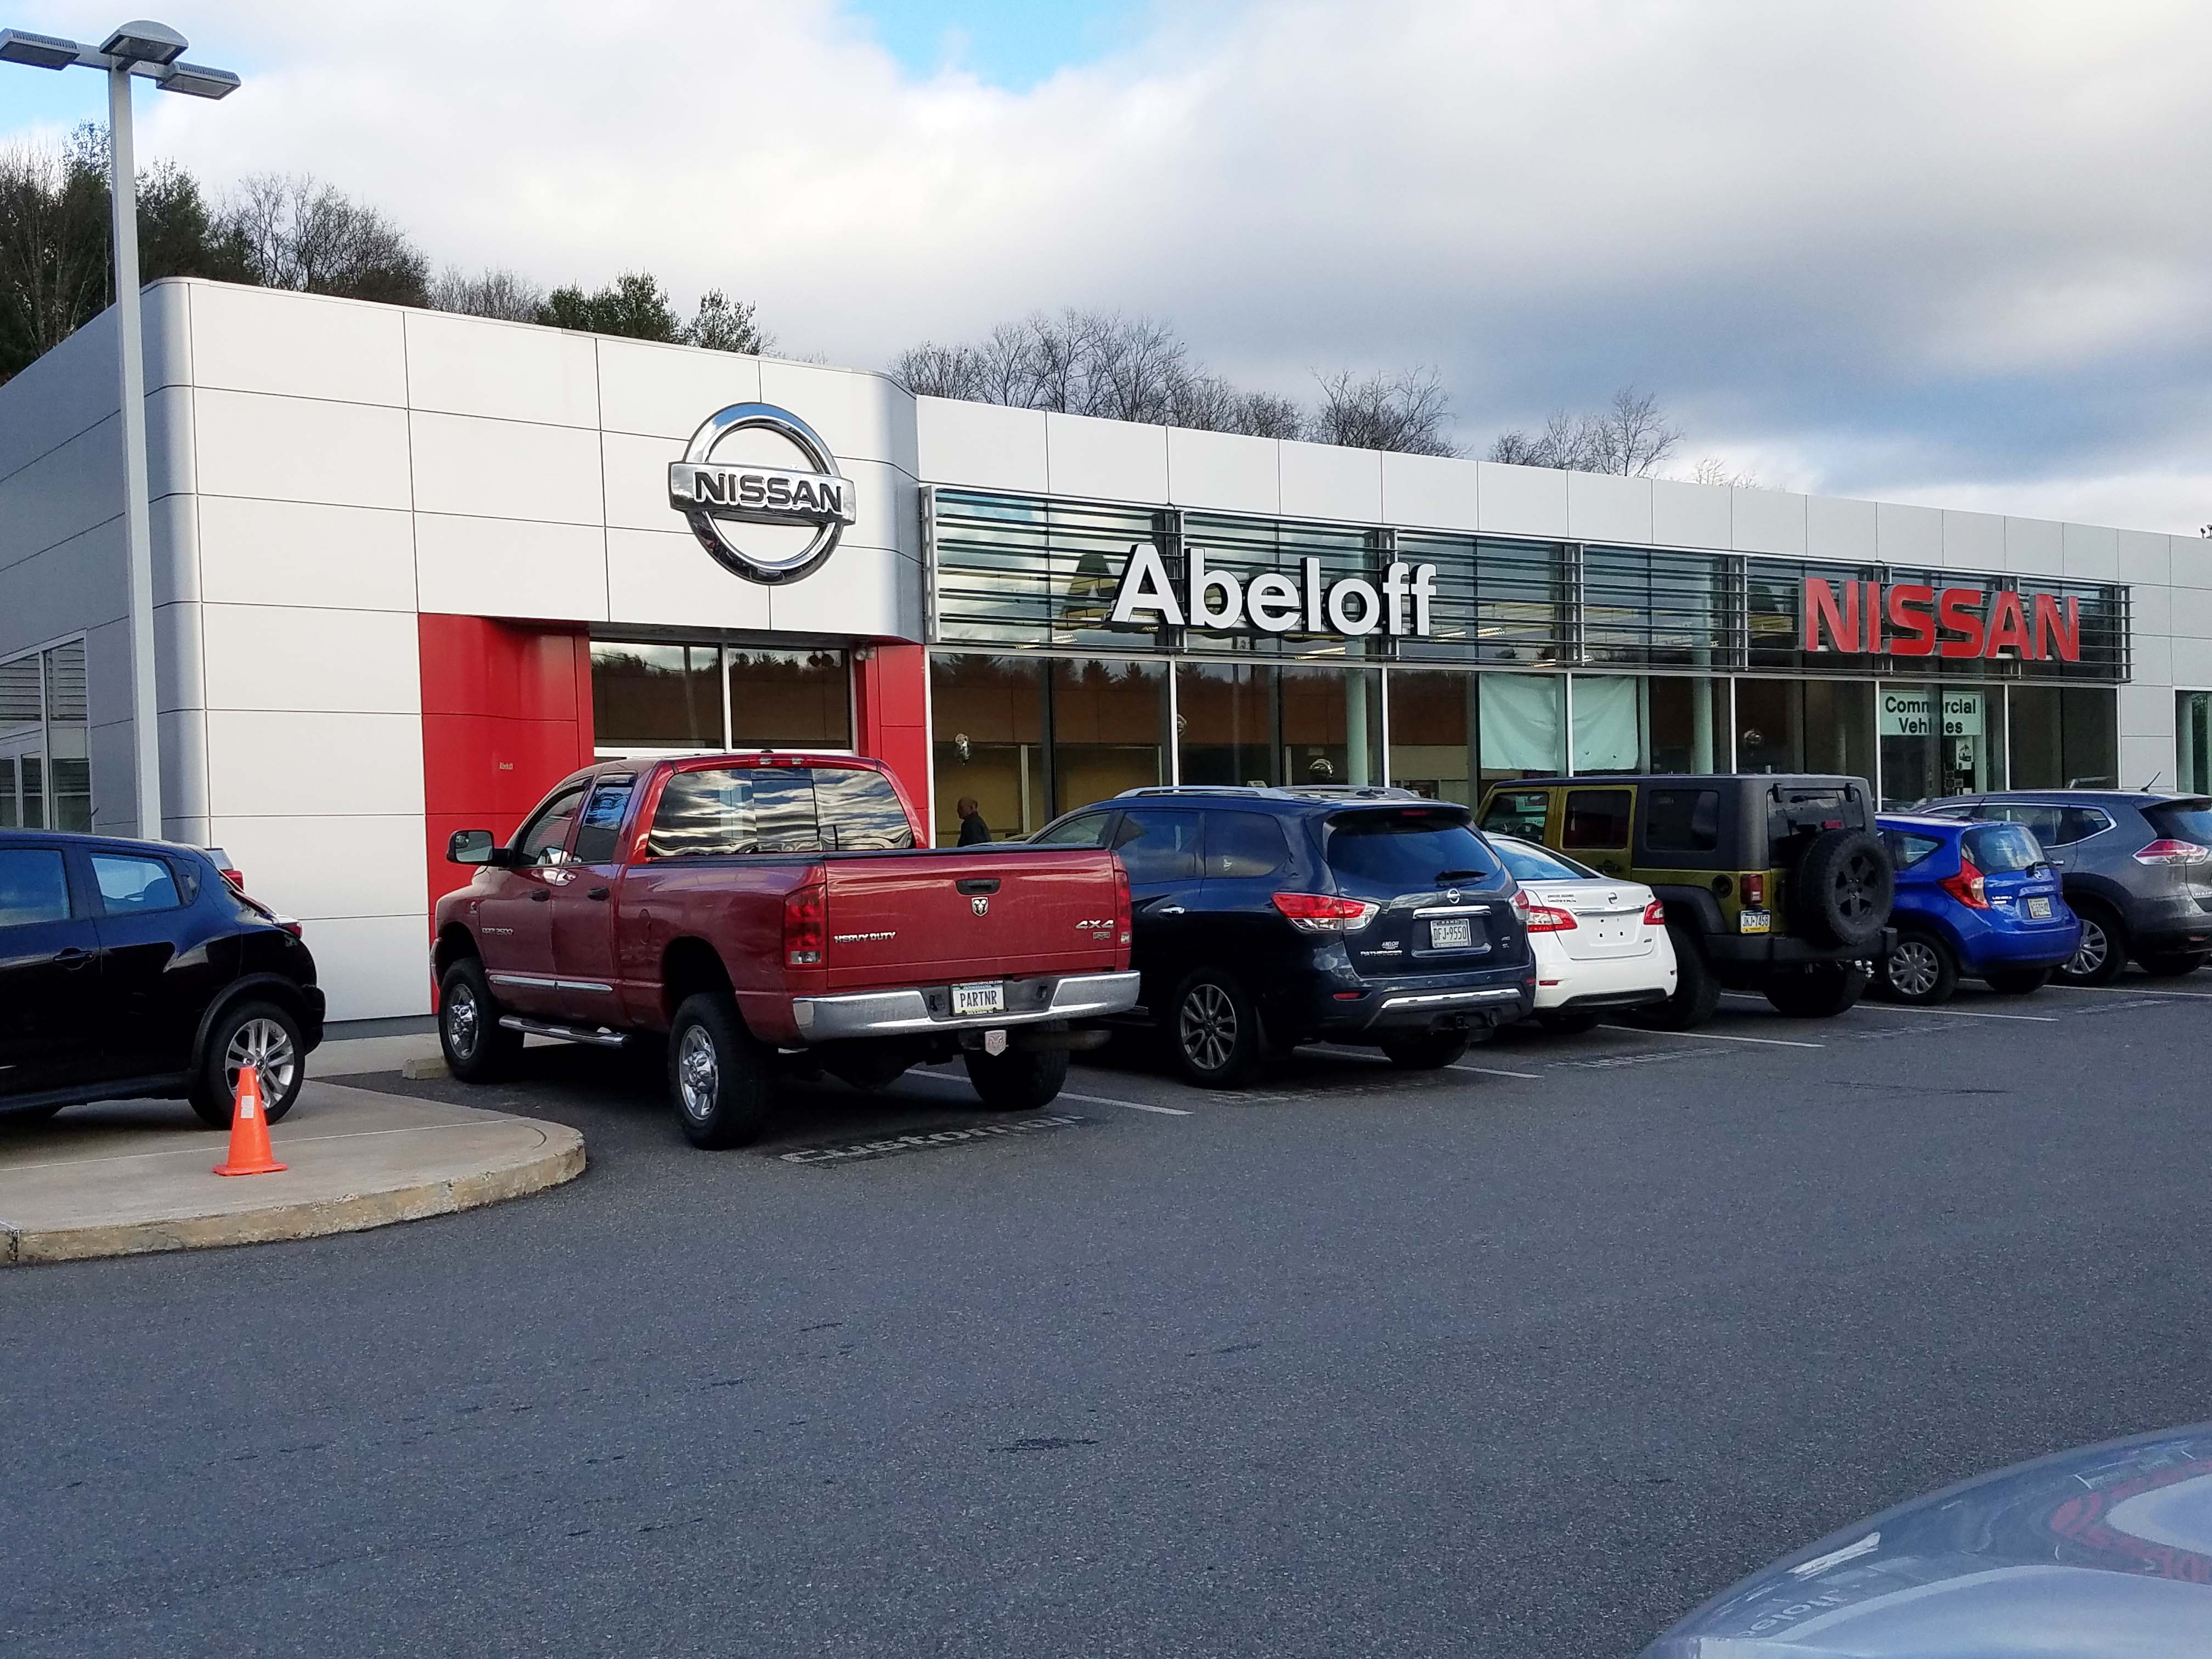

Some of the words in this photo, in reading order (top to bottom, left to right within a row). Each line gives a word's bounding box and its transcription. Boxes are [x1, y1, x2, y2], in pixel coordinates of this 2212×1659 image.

[694, 471, 843, 514] NISSAN
[1108, 542, 1437, 636] Abeloff
[1803, 577, 2080, 662] NISSAN
[1885, 696, 1977, 714] Commrcial
[1898, 717, 1963, 734] Vehies
[834, 934, 868, 943] HEAVY
[870, 932, 896, 941] DUTY
[960, 990, 997, 1008] PARTNR
